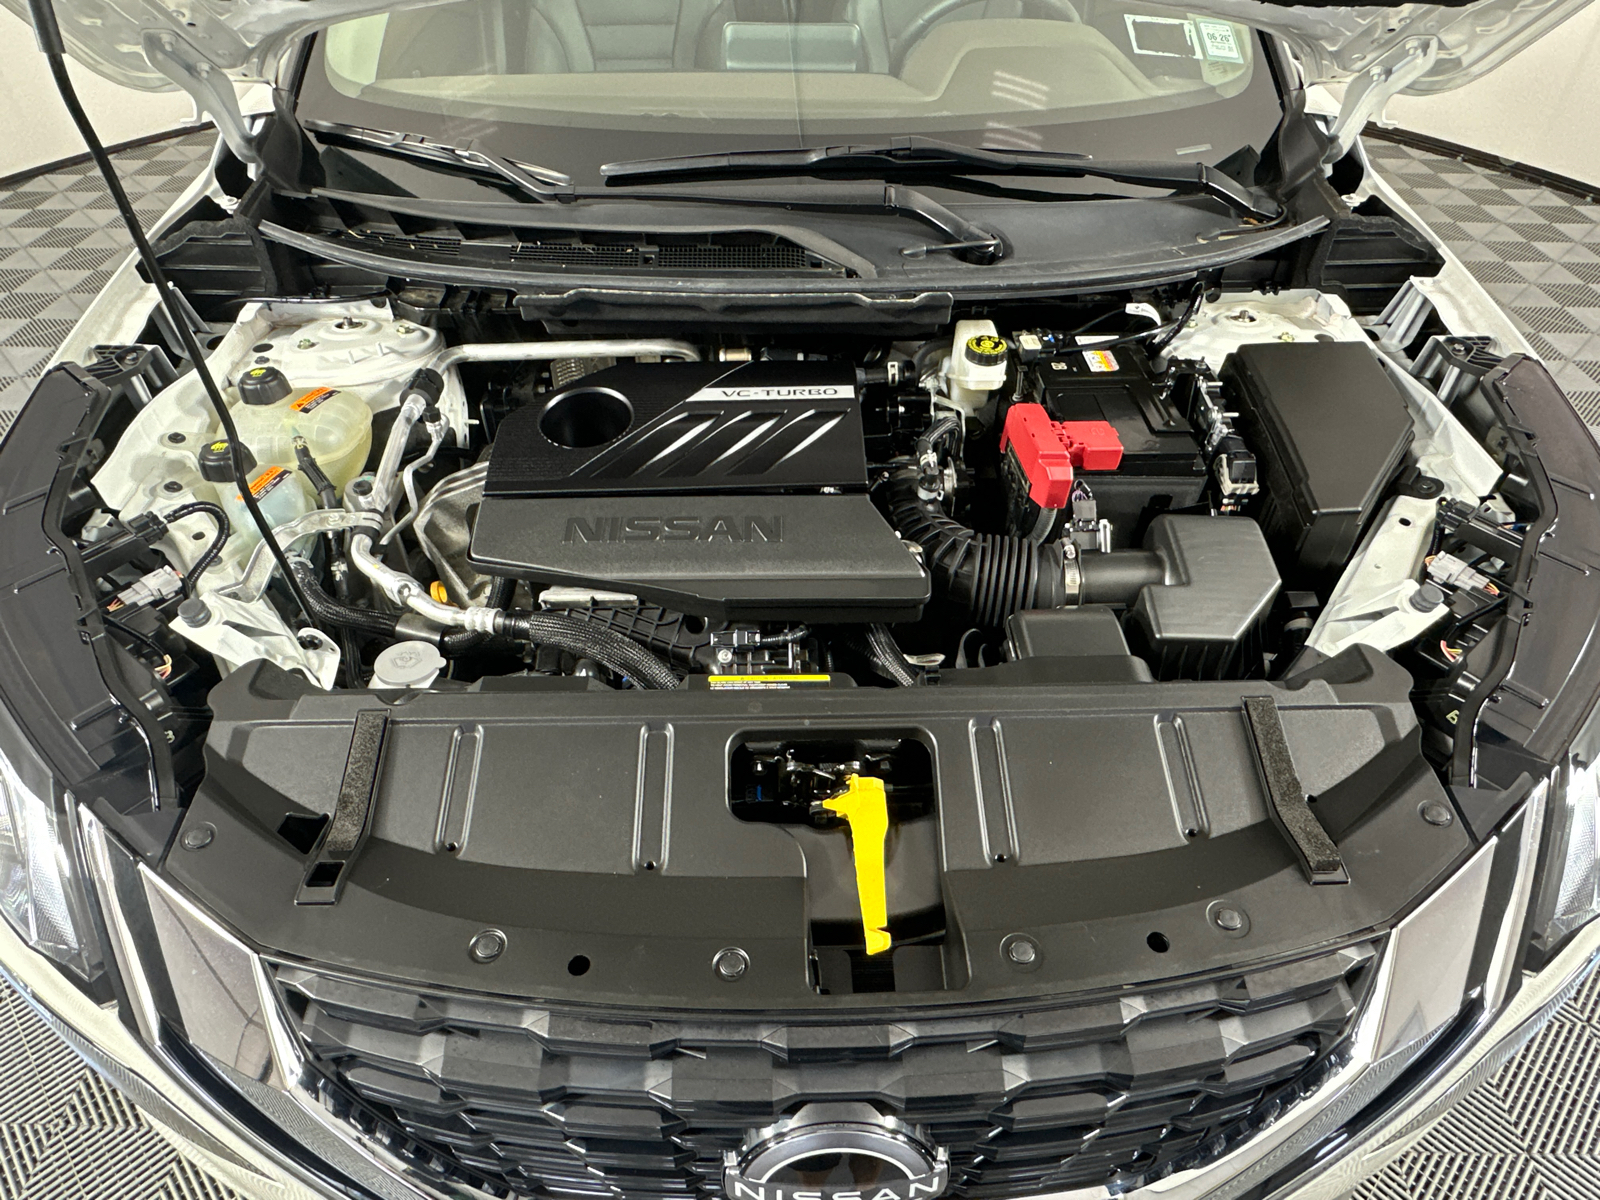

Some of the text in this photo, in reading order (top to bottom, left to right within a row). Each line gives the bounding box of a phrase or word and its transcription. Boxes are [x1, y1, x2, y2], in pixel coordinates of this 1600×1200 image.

[1207, 32, 1218, 41] 06
[562, 515, 783, 544] NISSAN
[734, 1176, 938, 1200] NISSAN
